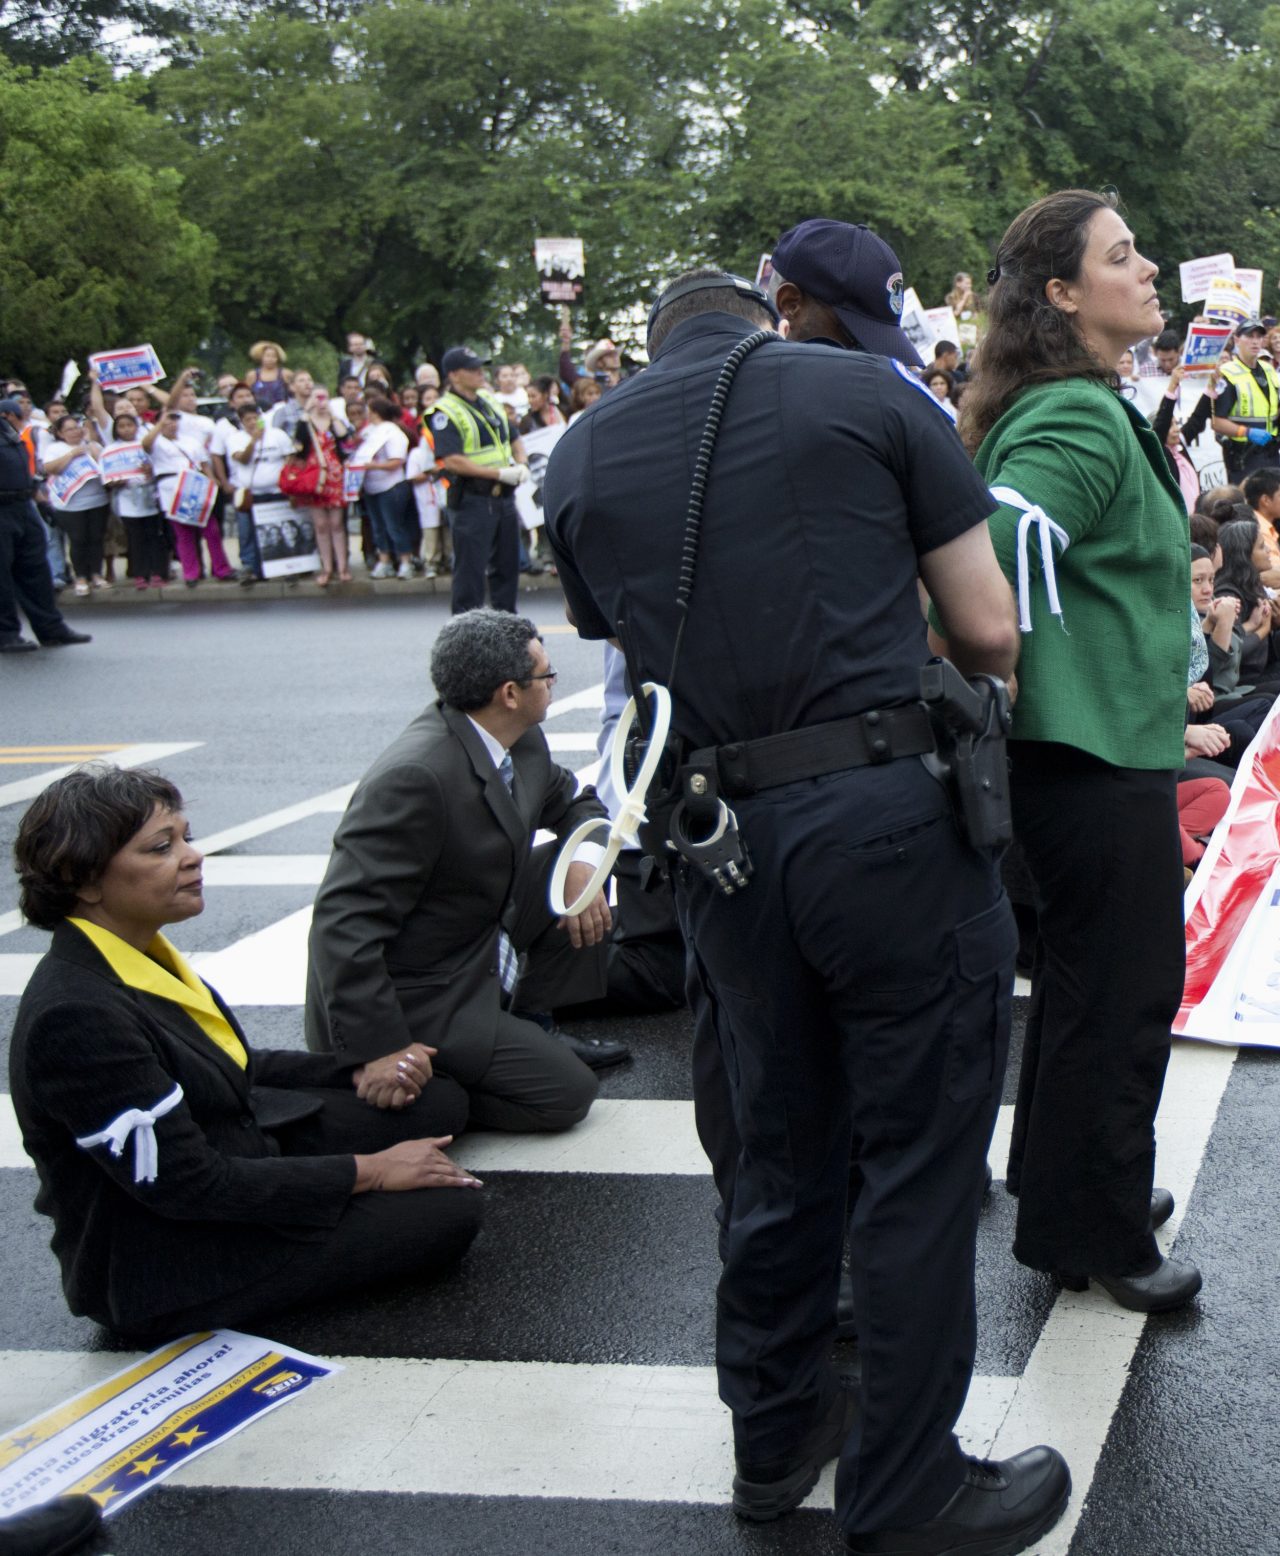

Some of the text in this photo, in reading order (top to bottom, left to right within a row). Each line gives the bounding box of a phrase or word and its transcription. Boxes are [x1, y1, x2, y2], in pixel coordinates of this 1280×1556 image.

[62, 1386, 170, 1455] migratoria
[173, 1344, 233, 1385] ahora!
[261, 1373, 303, 1397] SEIU
[56, 1418, 140, 1474] nuestras
[141, 1371, 212, 1416] familias
[129, 1425, 170, 1457] AHORA
[172, 1414, 184, 1427] al
